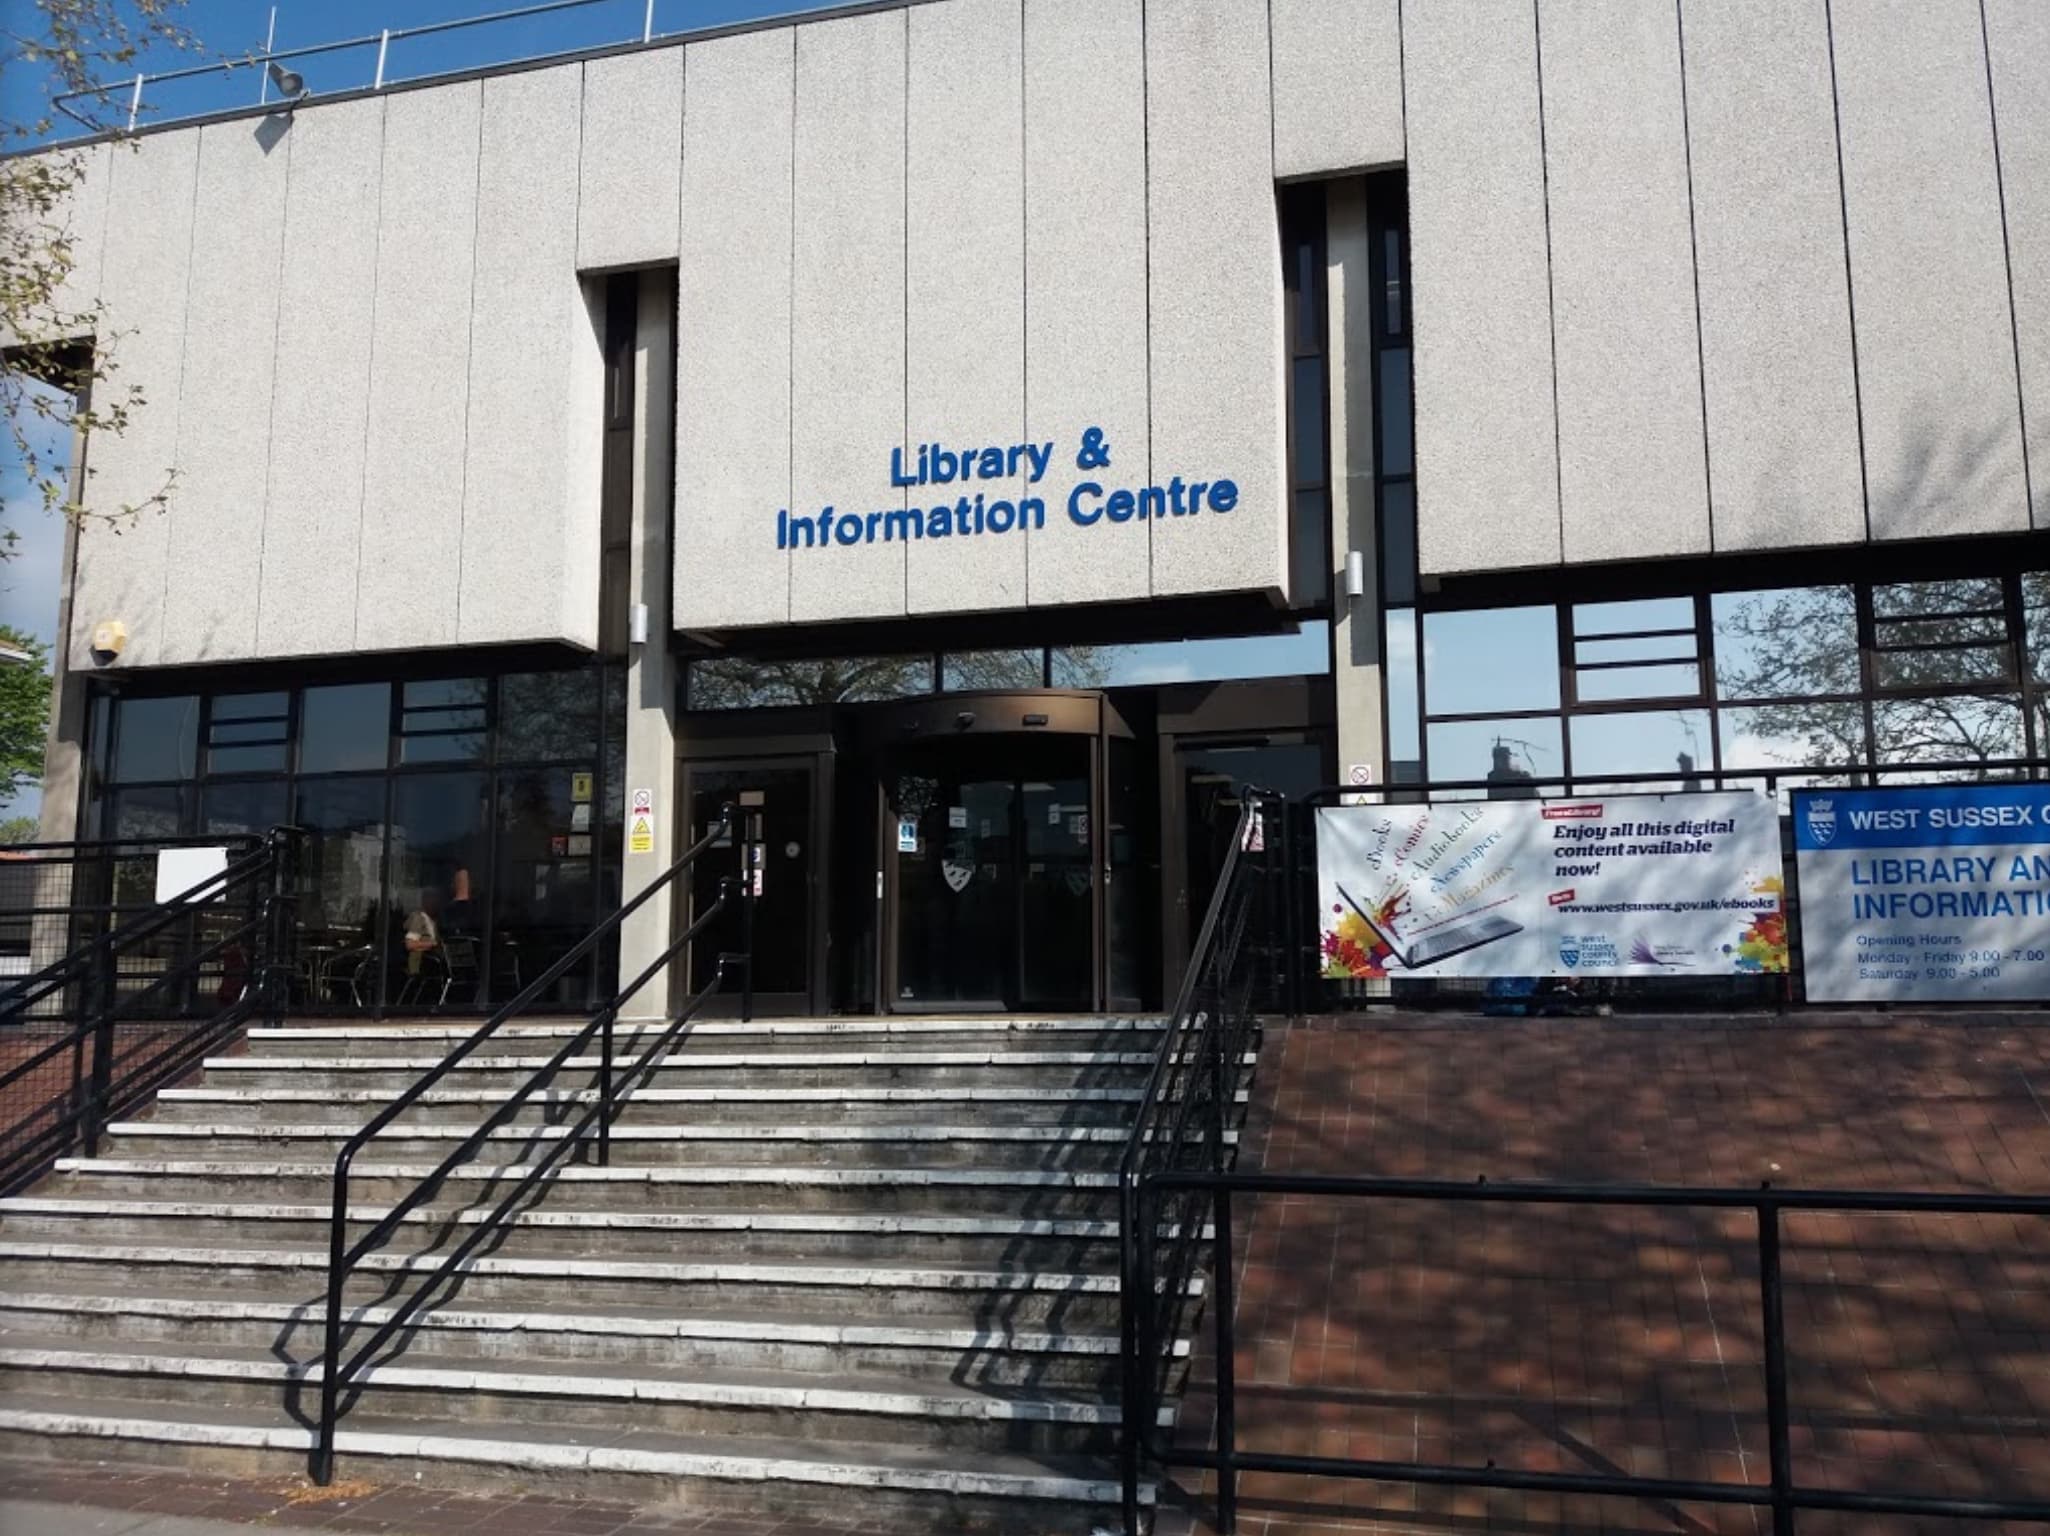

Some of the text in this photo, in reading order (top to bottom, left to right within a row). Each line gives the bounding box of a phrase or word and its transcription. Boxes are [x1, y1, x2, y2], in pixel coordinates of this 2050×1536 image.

[890, 426, 1111, 487] Library &
[776, 474, 1239, 549] Information Centre
[1849, 809, 1920, 830] WEST
[1929, 806, 2034, 828] SUSSEX
[1553, 819, 1735, 842] Enjoy all this digital
[1411, 806, 1484, 881] eAudiobooks
[1554, 840, 1713, 858] content available
[1431, 831, 1503, 893] eNewspapers
[1555, 862, 1601, 877] now!
[1852, 856, 1996, 885] LIBRARY
[1558, 897, 1774, 914] www.westsussex.gov.uk/ebooks
[1854, 890, 2050, 919] INFORMATI
[1856, 934, 1962, 947] Opening Hours
[1857, 952, 1910, 965] Monday
[1924, 951, 1966, 965] Friday
[2014, 950, 2045, 961] 7.00
[1859, 968, 1918, 981] Saturday
[1926, 967, 1956, 979] 9.00
[1969, 966, 2000, 979] 5.00
